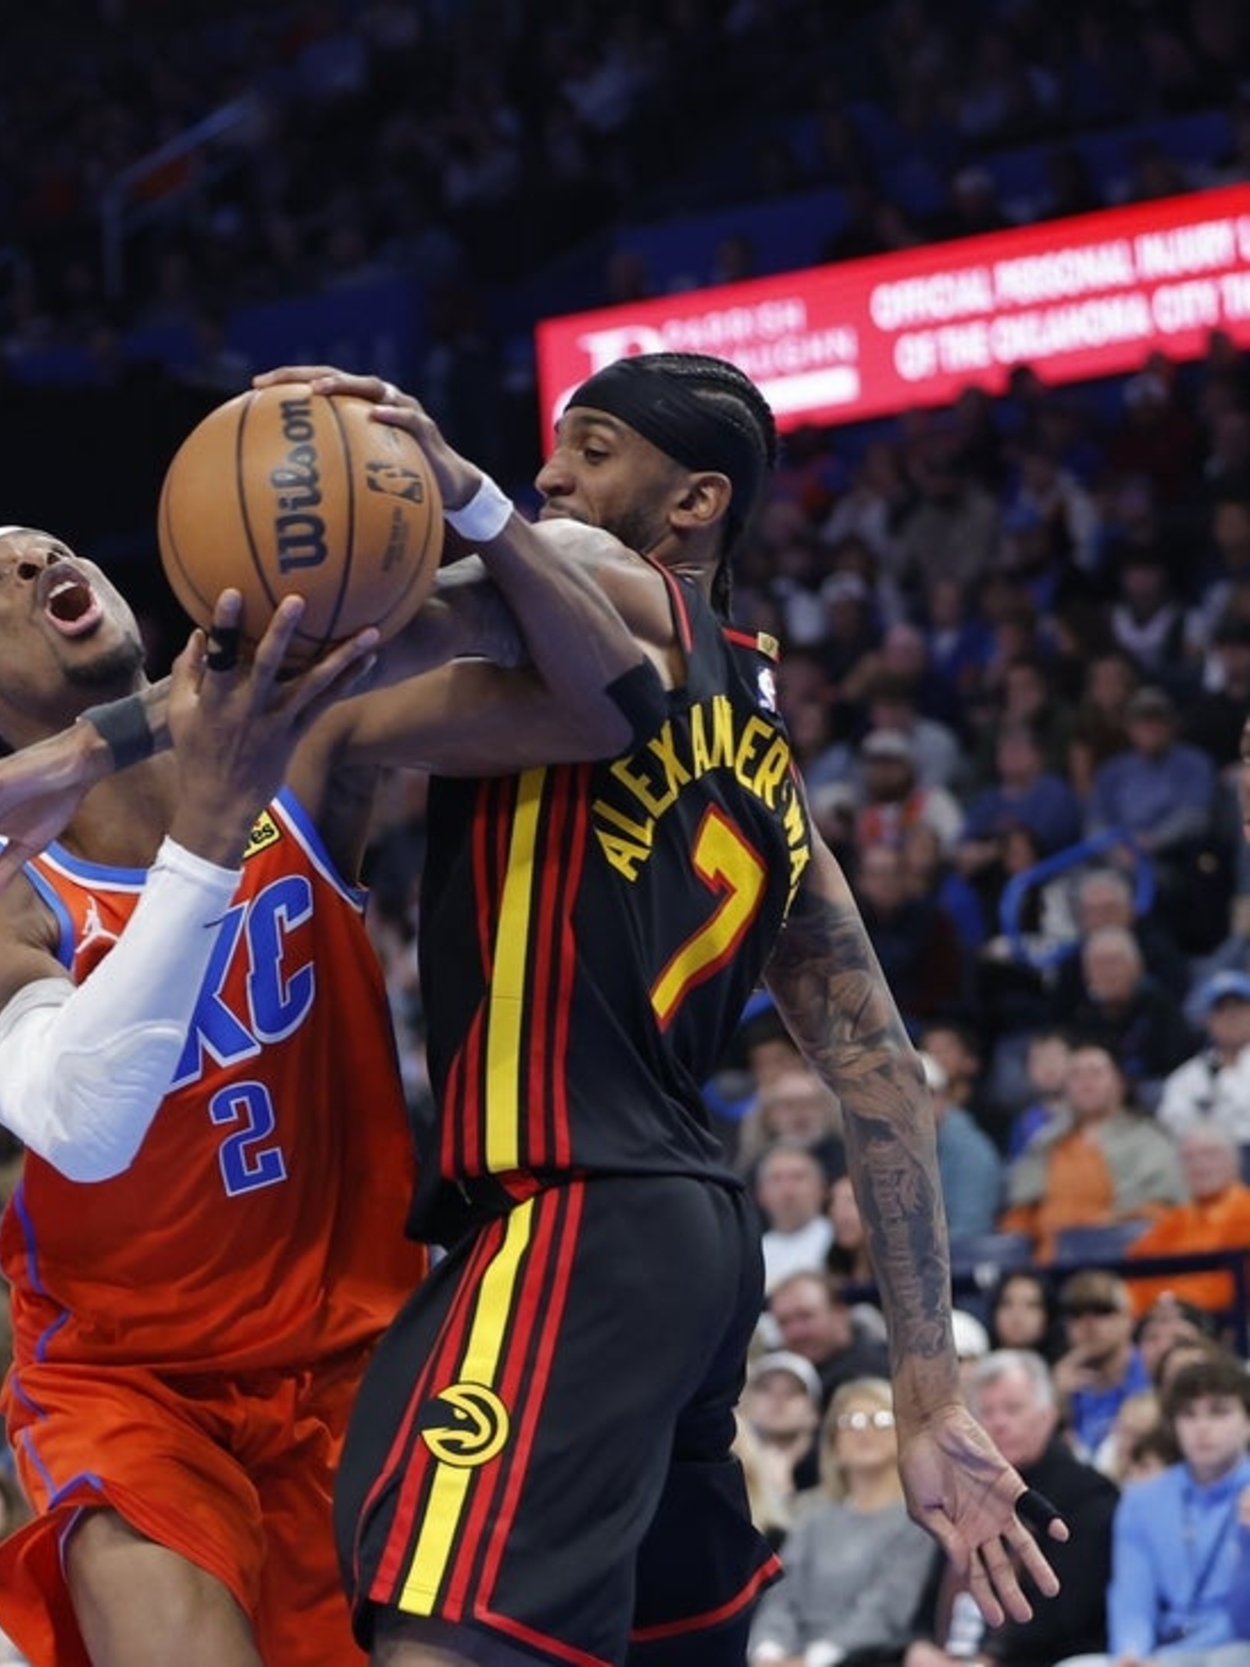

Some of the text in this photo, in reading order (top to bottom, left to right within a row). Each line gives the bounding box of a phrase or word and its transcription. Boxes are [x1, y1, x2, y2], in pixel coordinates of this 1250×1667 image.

[869, 265, 992, 332] OFFICIAL
[1133, 216, 1237, 280] INJURY
[893, 332, 939, 381] OF
[938, 320, 992, 374] THE
[989, 290, 1153, 363] OKLAHOMA
[1151, 277, 1219, 334] CITY
[270, 398, 329, 576] Wilson
[166, 875, 314, 1088] KC
[650, 803, 769, 1035] 7
[209, 1081, 288, 1198] 2
